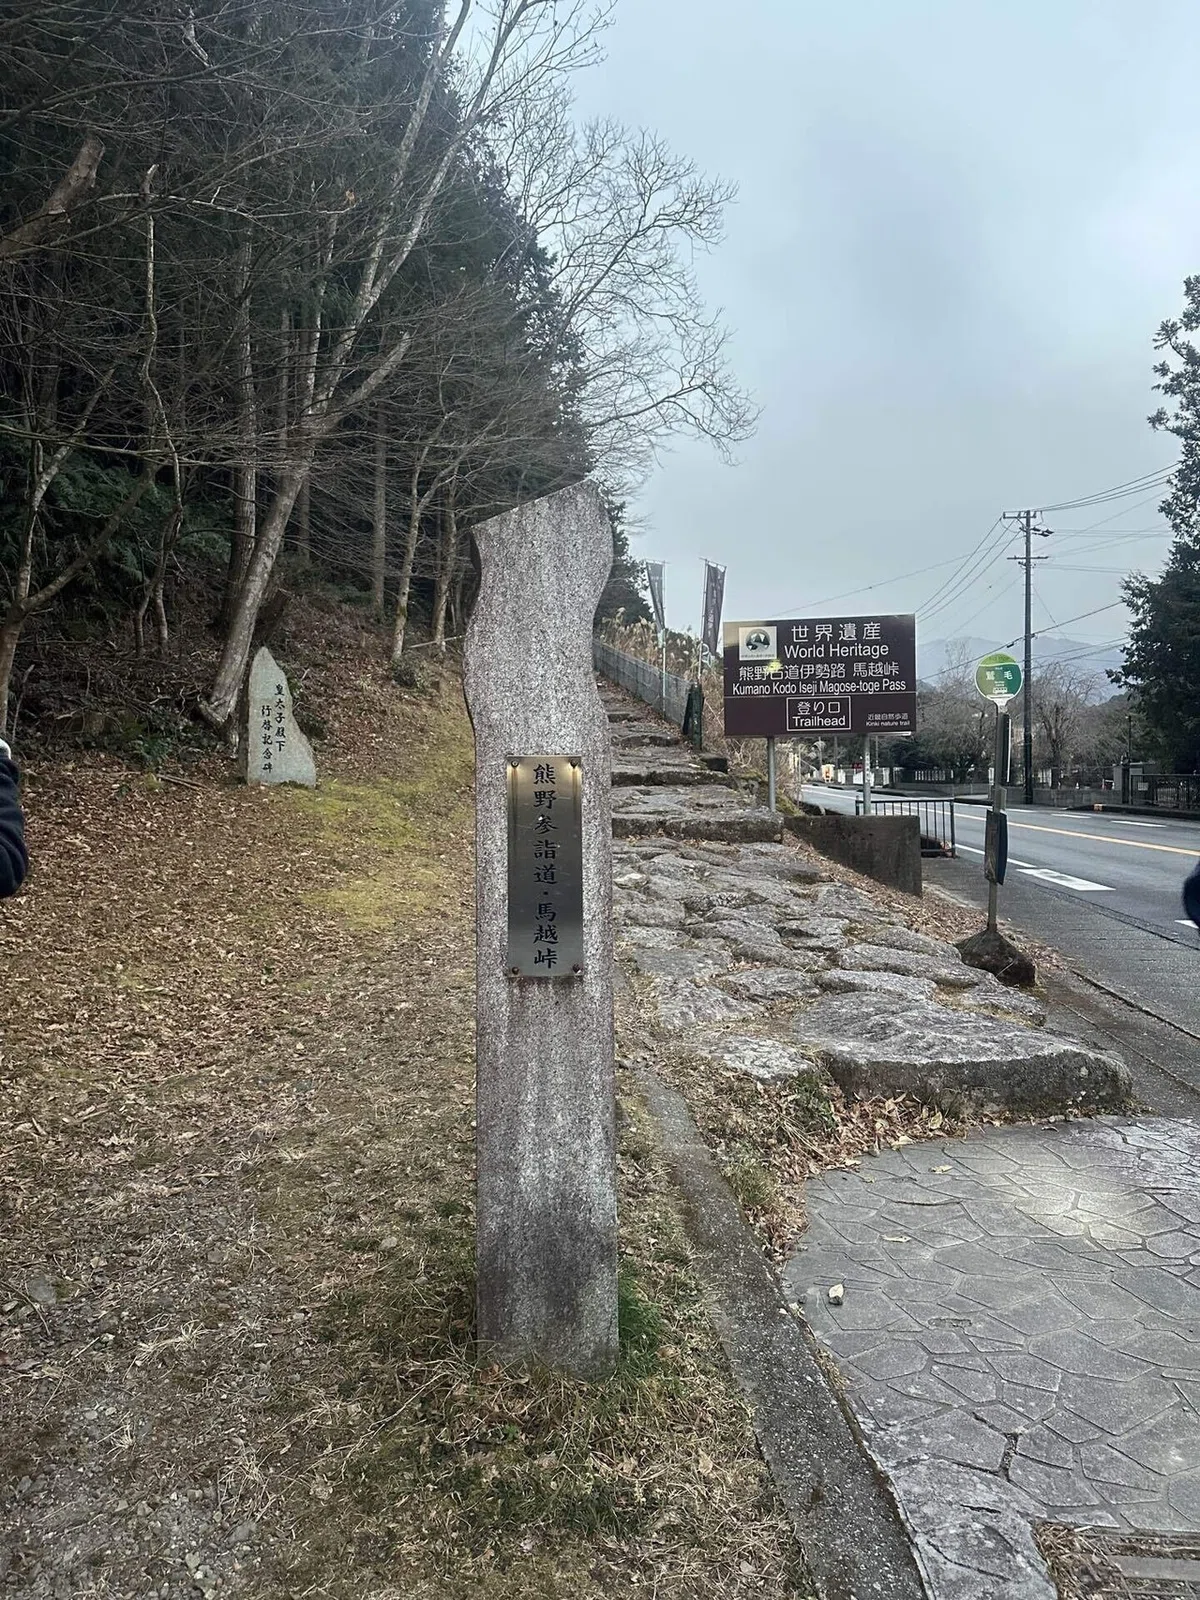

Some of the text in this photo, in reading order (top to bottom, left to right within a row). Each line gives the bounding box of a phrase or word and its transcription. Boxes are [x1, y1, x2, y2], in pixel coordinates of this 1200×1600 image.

[791, 621, 882, 643] 世界遺産
[784, 642, 889, 659] World Heritage
[739, 661, 900, 681] 熊野古道伊勢路 馬越峠
[986, 670, 1013, 680] 毛
[732, 679, 906, 696] Kumano Kodo Iseji Magose-toge Pass
[797, 701, 840, 715] 登り口
[274, 683, 286, 752] 皇太子殿下
[792, 715, 846, 727] Trailhead
[533, 763, 559, 969] 熊野参詣道・馬越峠
